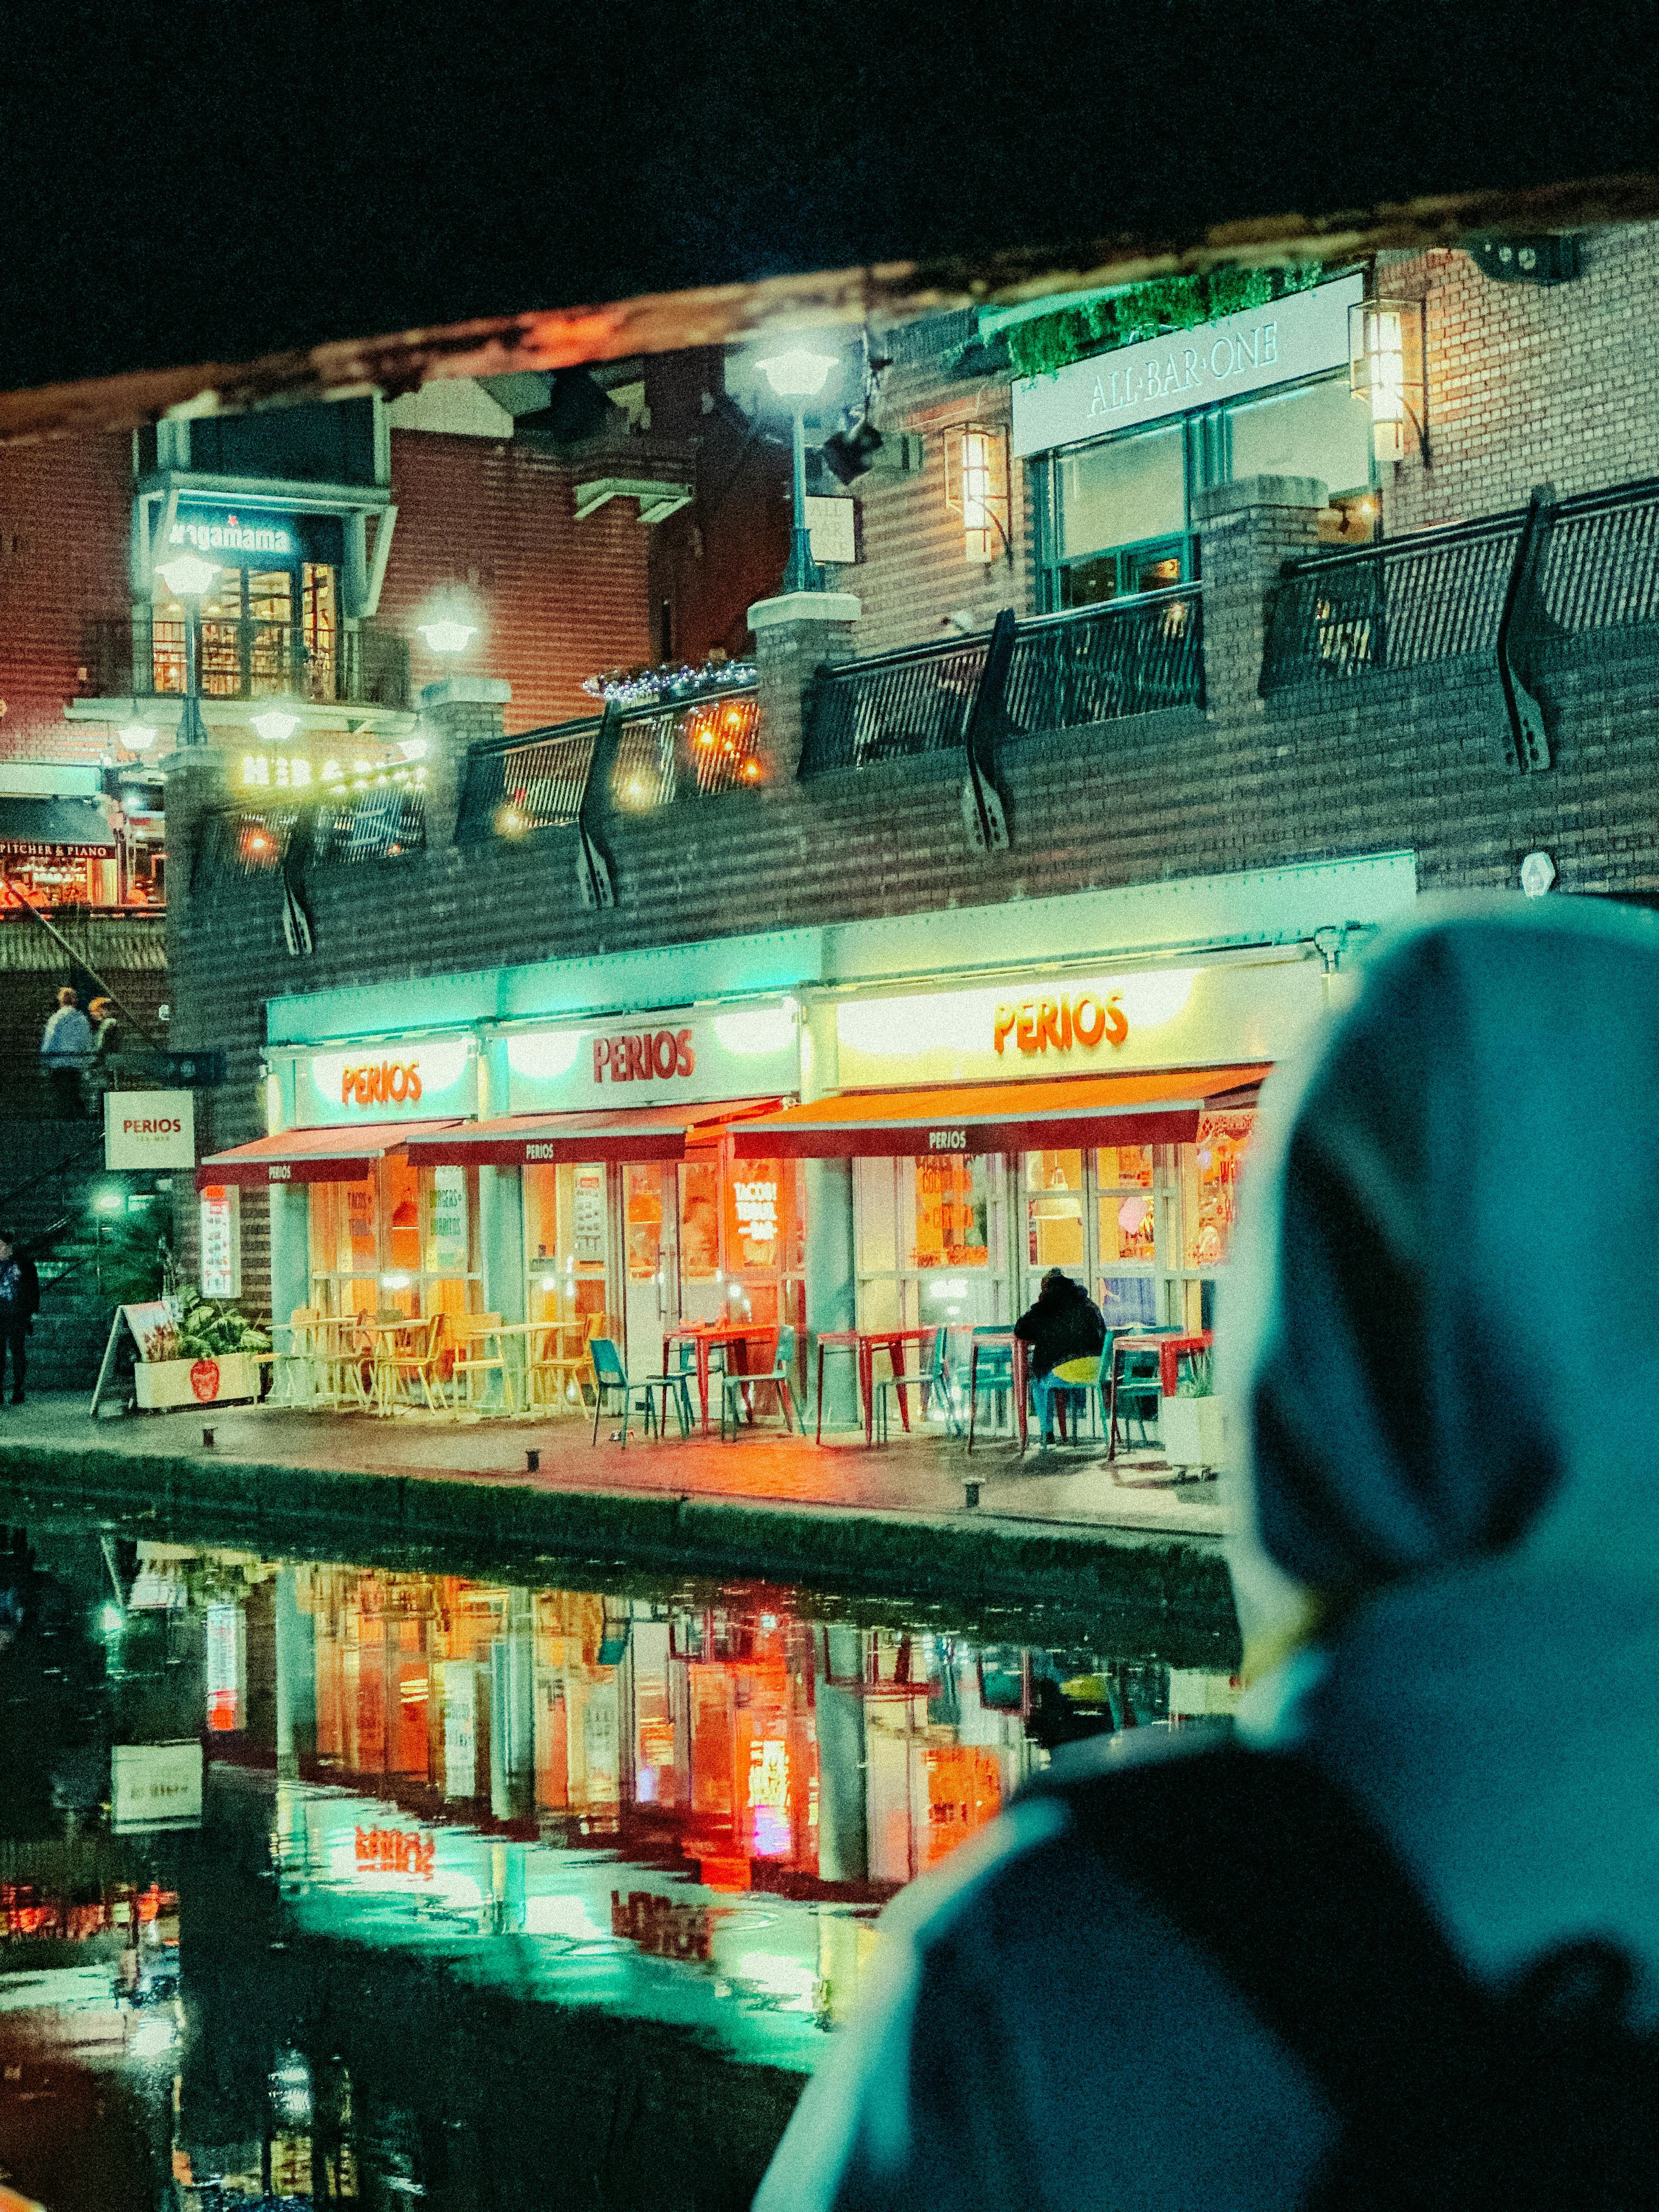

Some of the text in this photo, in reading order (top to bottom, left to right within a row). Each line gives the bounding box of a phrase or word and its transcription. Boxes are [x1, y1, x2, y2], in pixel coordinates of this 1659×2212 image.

[1087, 321, 1278, 417] ALL BAR ONE
[0, 843, 107, 856] PITCHER & PIANO
[994, 990, 1129, 1056] PERIOS
[592, 1030, 695, 1084] PERIOS
[341, 1059, 422, 1105] PERIOS
[123, 1119, 181, 1133] PERIOS
[929, 1131, 966, 1149] PERIOS
[526, 1143, 554, 1160] PERIOS
[269, 1165, 291, 1180] PERIOS
